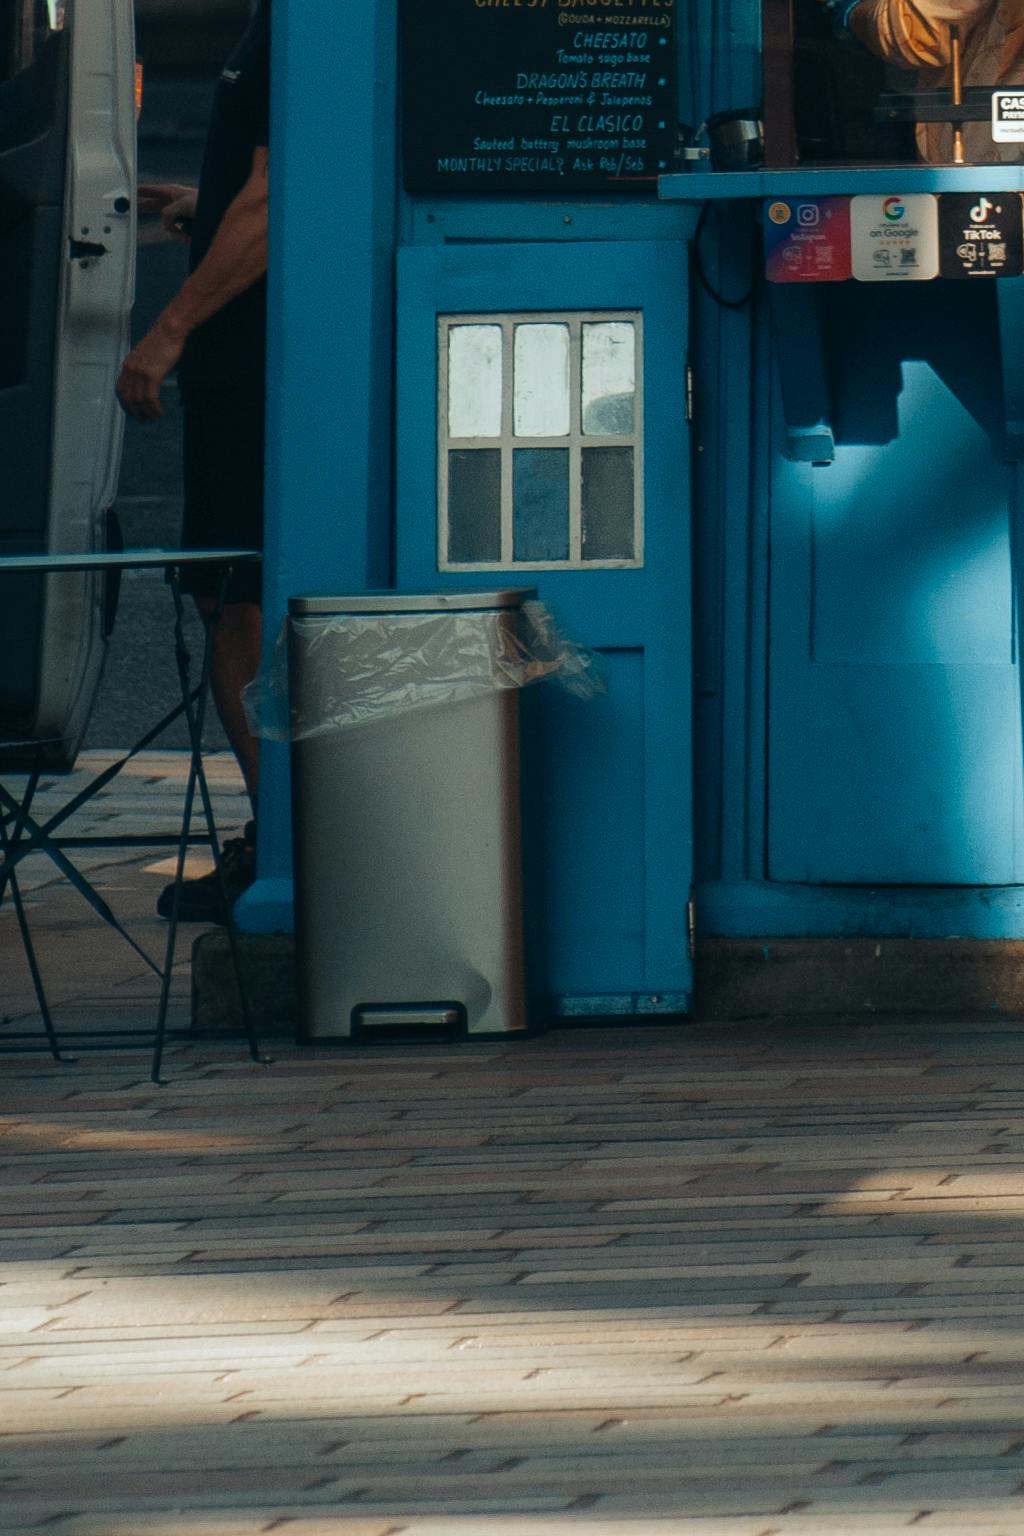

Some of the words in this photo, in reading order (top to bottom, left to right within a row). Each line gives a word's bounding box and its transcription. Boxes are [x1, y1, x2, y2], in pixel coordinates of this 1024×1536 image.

[604, 14, 671, 29] MOZZARELLA)
[573, 31, 648, 49] CHEESATO
[556, 49, 594, 64] Tomato
[626, 52, 651, 64] base
[590, 72, 647, 89] BREATH
[474, 90, 525, 106] Cheesato
[535, 91, 584, 106] Pepperoni
[550, 114, 570, 132] EL
[577, 114, 643, 132] CLASICO
[567, 137, 619, 150] mushroom
[622, 136, 647, 149] base
[437, 156, 502, 173] MONTHLY
[884, 228, 919, 239] Google
[962, 229, 1002, 241] TikTok
